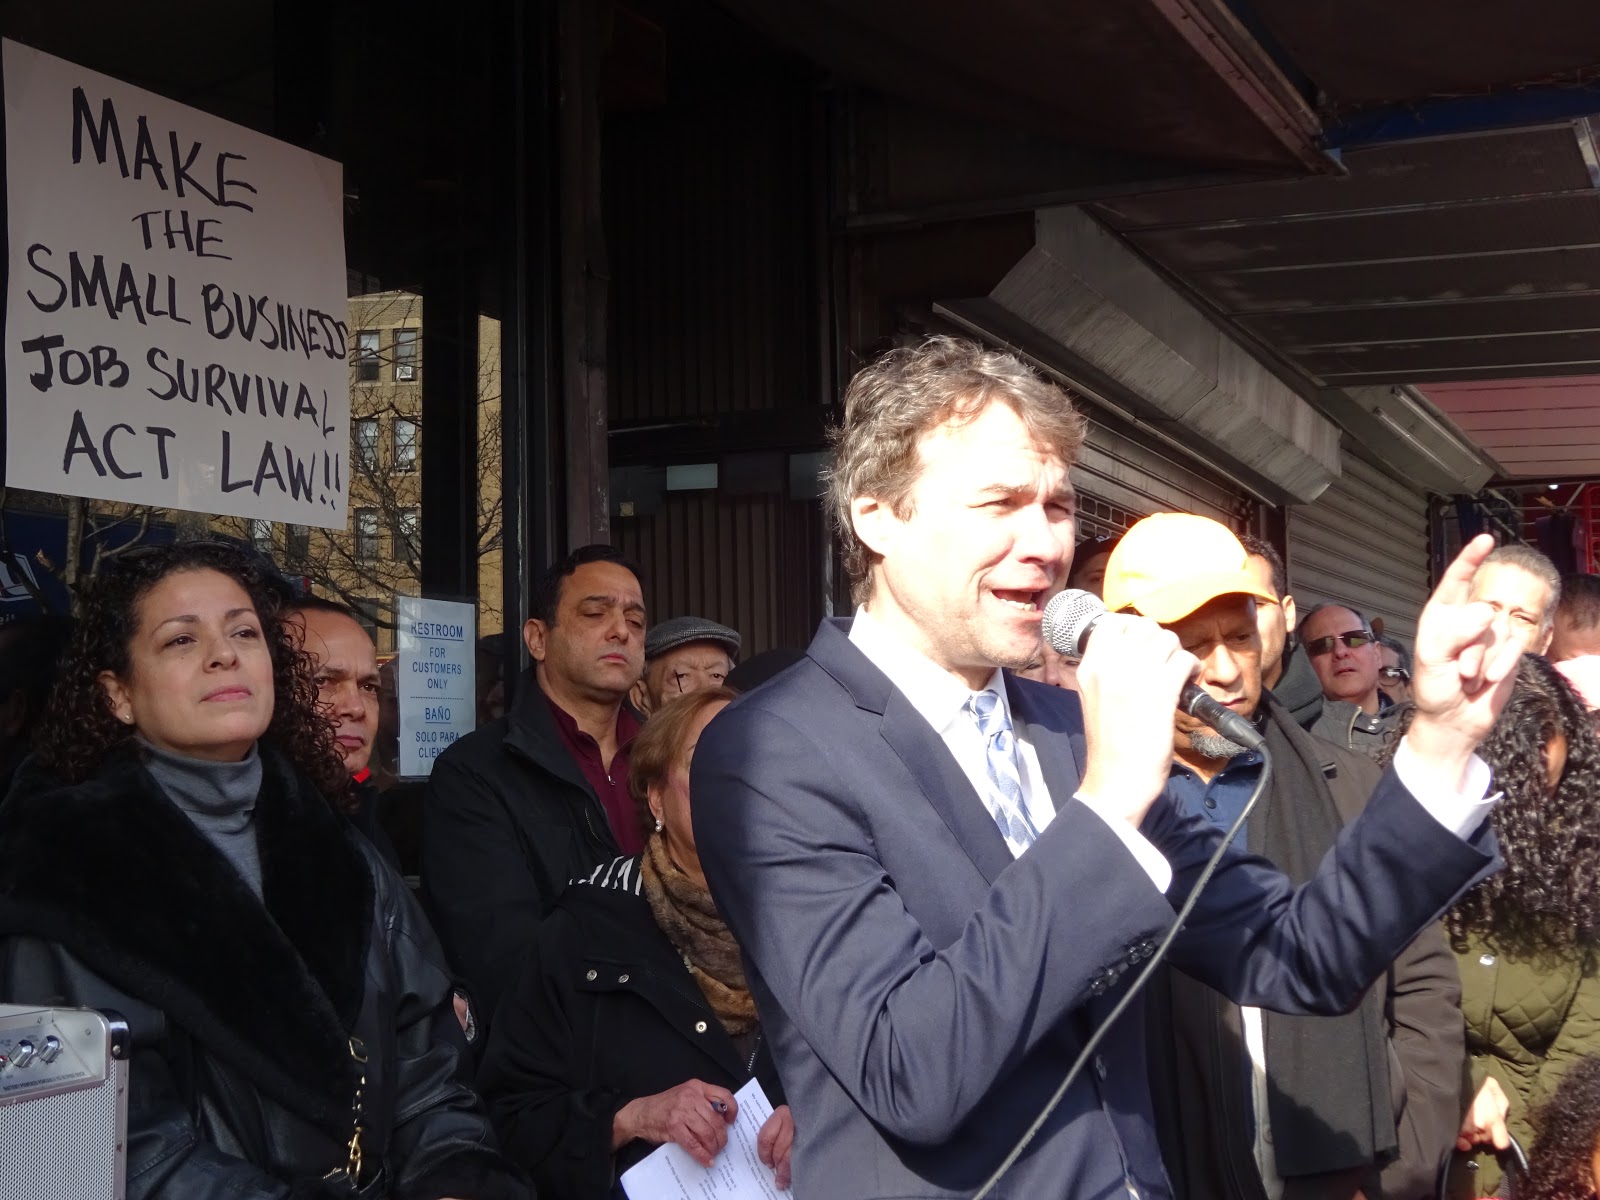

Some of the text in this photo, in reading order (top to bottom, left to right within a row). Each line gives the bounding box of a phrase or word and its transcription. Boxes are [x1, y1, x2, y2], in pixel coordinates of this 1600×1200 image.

[72, 86, 257, 213] MAKE
[132, 210, 232, 260] THE
[27, 243, 348, 360] SMALL BUSINESS
[21, 334, 335, 439] JOB SURVIVAL
[63, 409, 340, 510] ACT LAW!!
[411, 622, 463, 638] RESTROOM
[429, 647, 446, 658] FOR
[412, 661, 462, 675] CUSTOMERS
[427, 679, 448, 690] ONLY
[425, 706, 451, 721] BAÑO
[415, 731, 460, 742] SOLO PARA
